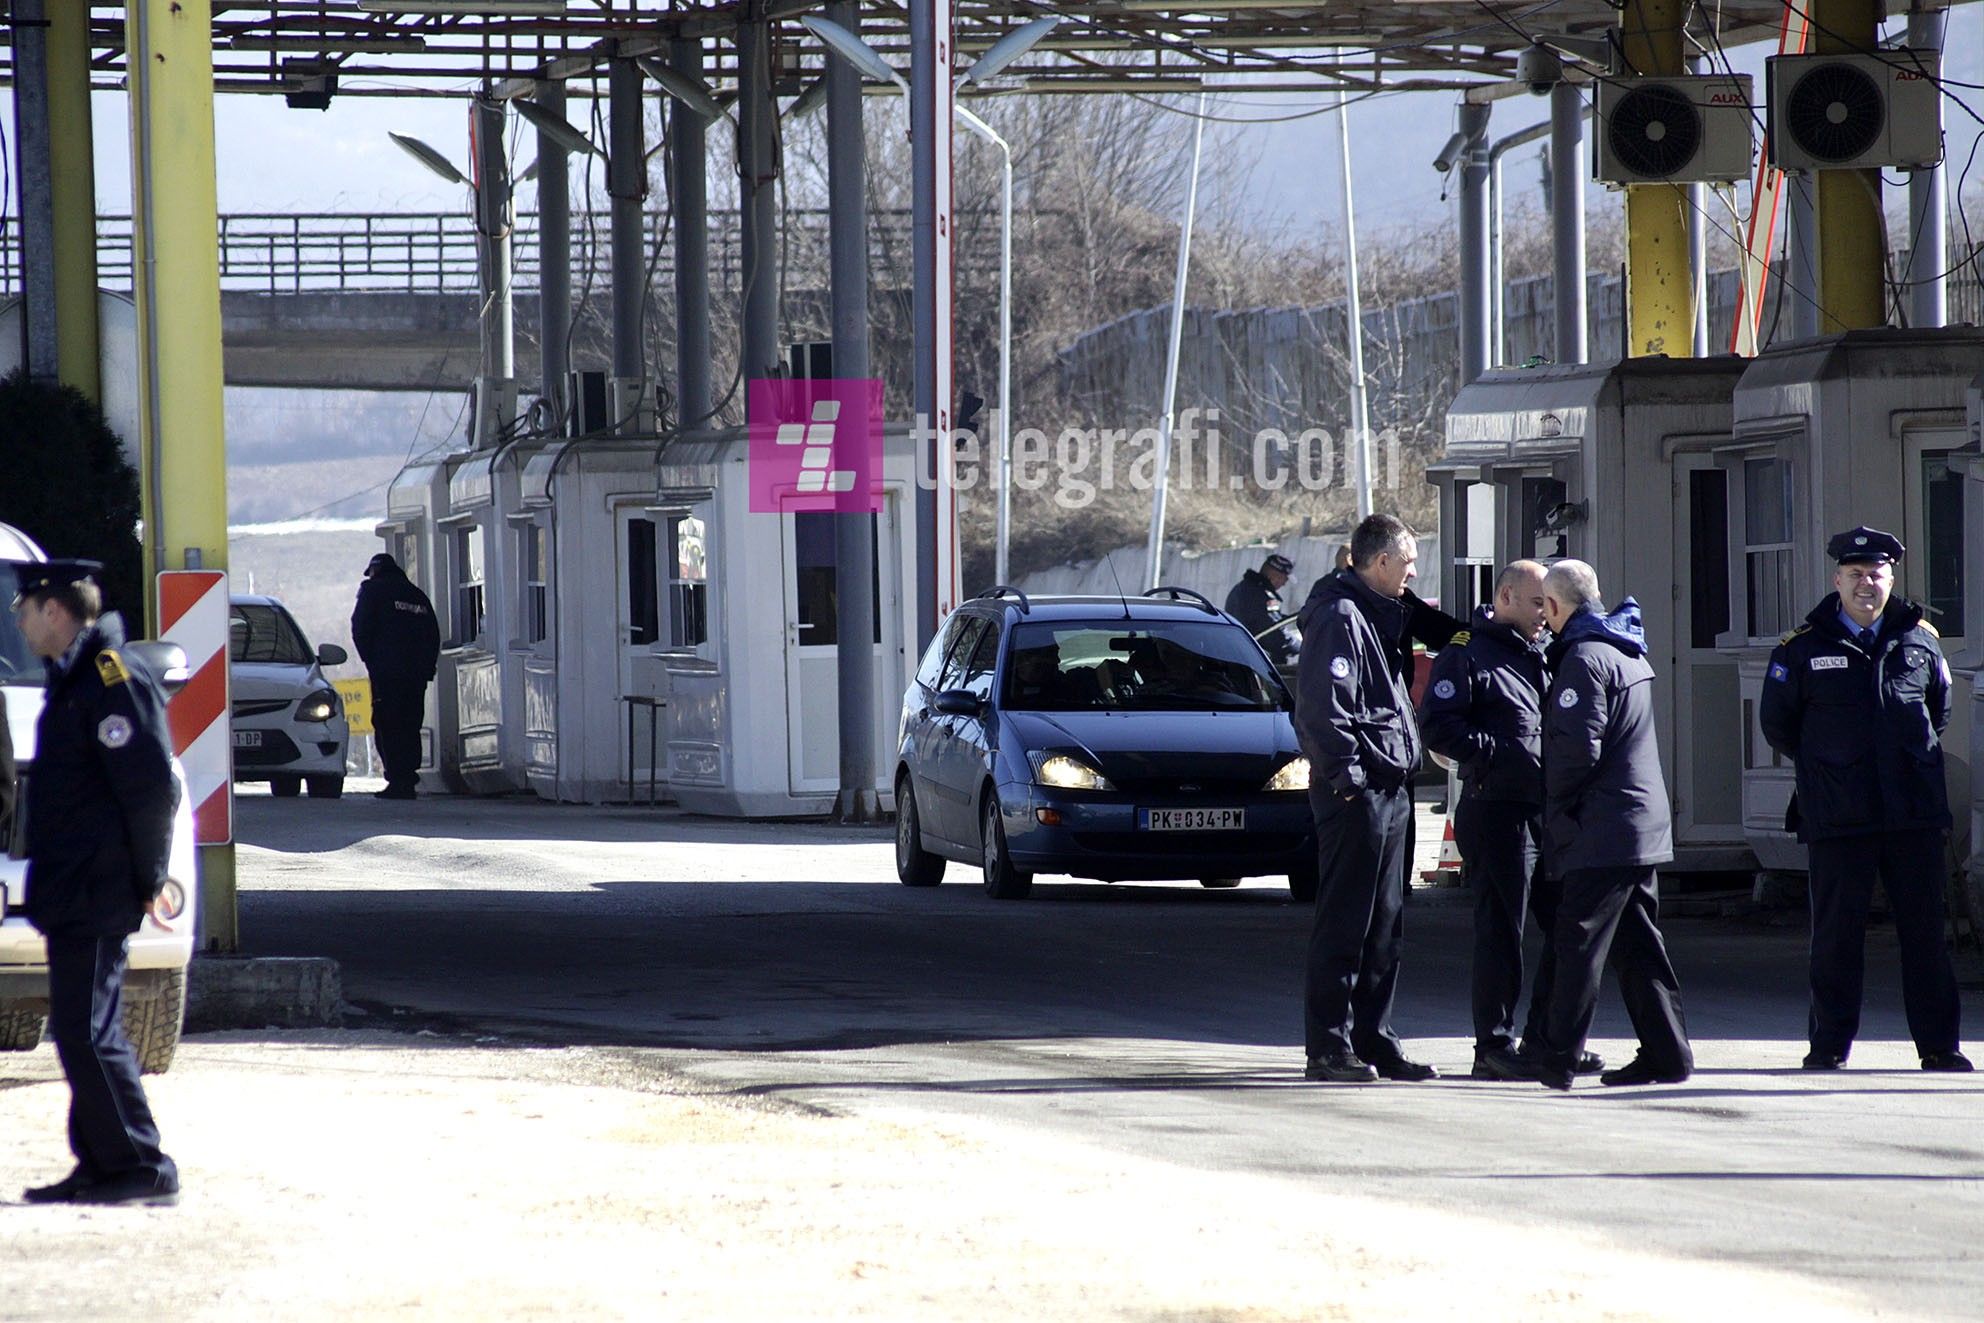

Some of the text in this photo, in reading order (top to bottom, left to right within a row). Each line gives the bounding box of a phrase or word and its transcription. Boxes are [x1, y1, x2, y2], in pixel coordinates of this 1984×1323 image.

[1711, 94, 1742, 105] AUX
[1812, 658, 1846, 669] POLICE
[236, 733, 260, 745] 1-DP
